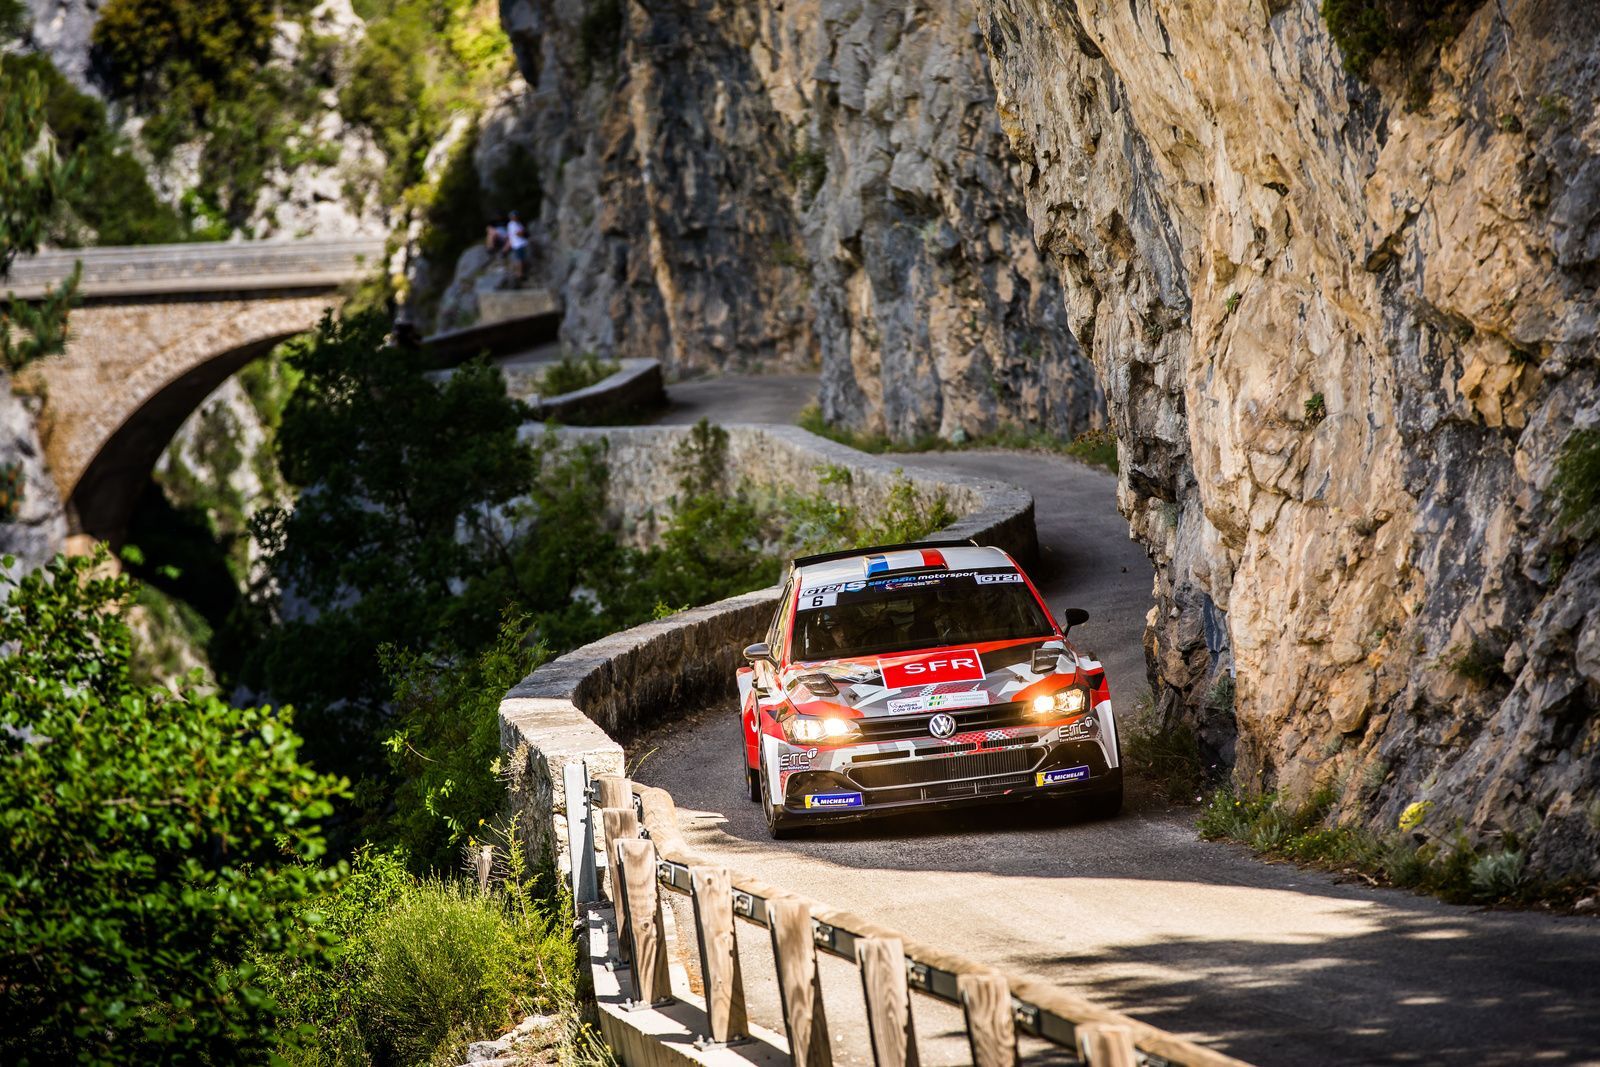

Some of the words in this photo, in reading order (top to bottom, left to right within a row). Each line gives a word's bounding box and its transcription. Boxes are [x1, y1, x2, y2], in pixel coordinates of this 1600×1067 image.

[868, 576, 916, 587] sarrazin
[917, 571, 979, 581] motorsport
[812, 595, 824, 607] 6
[903, 658, 976, 674] SFR
[1058, 722, 1089, 738] ETC
[780, 752, 810, 766] ETC
[1053, 771, 1085, 781] MICHELIN
[820, 797, 855, 805] MICHELIN
